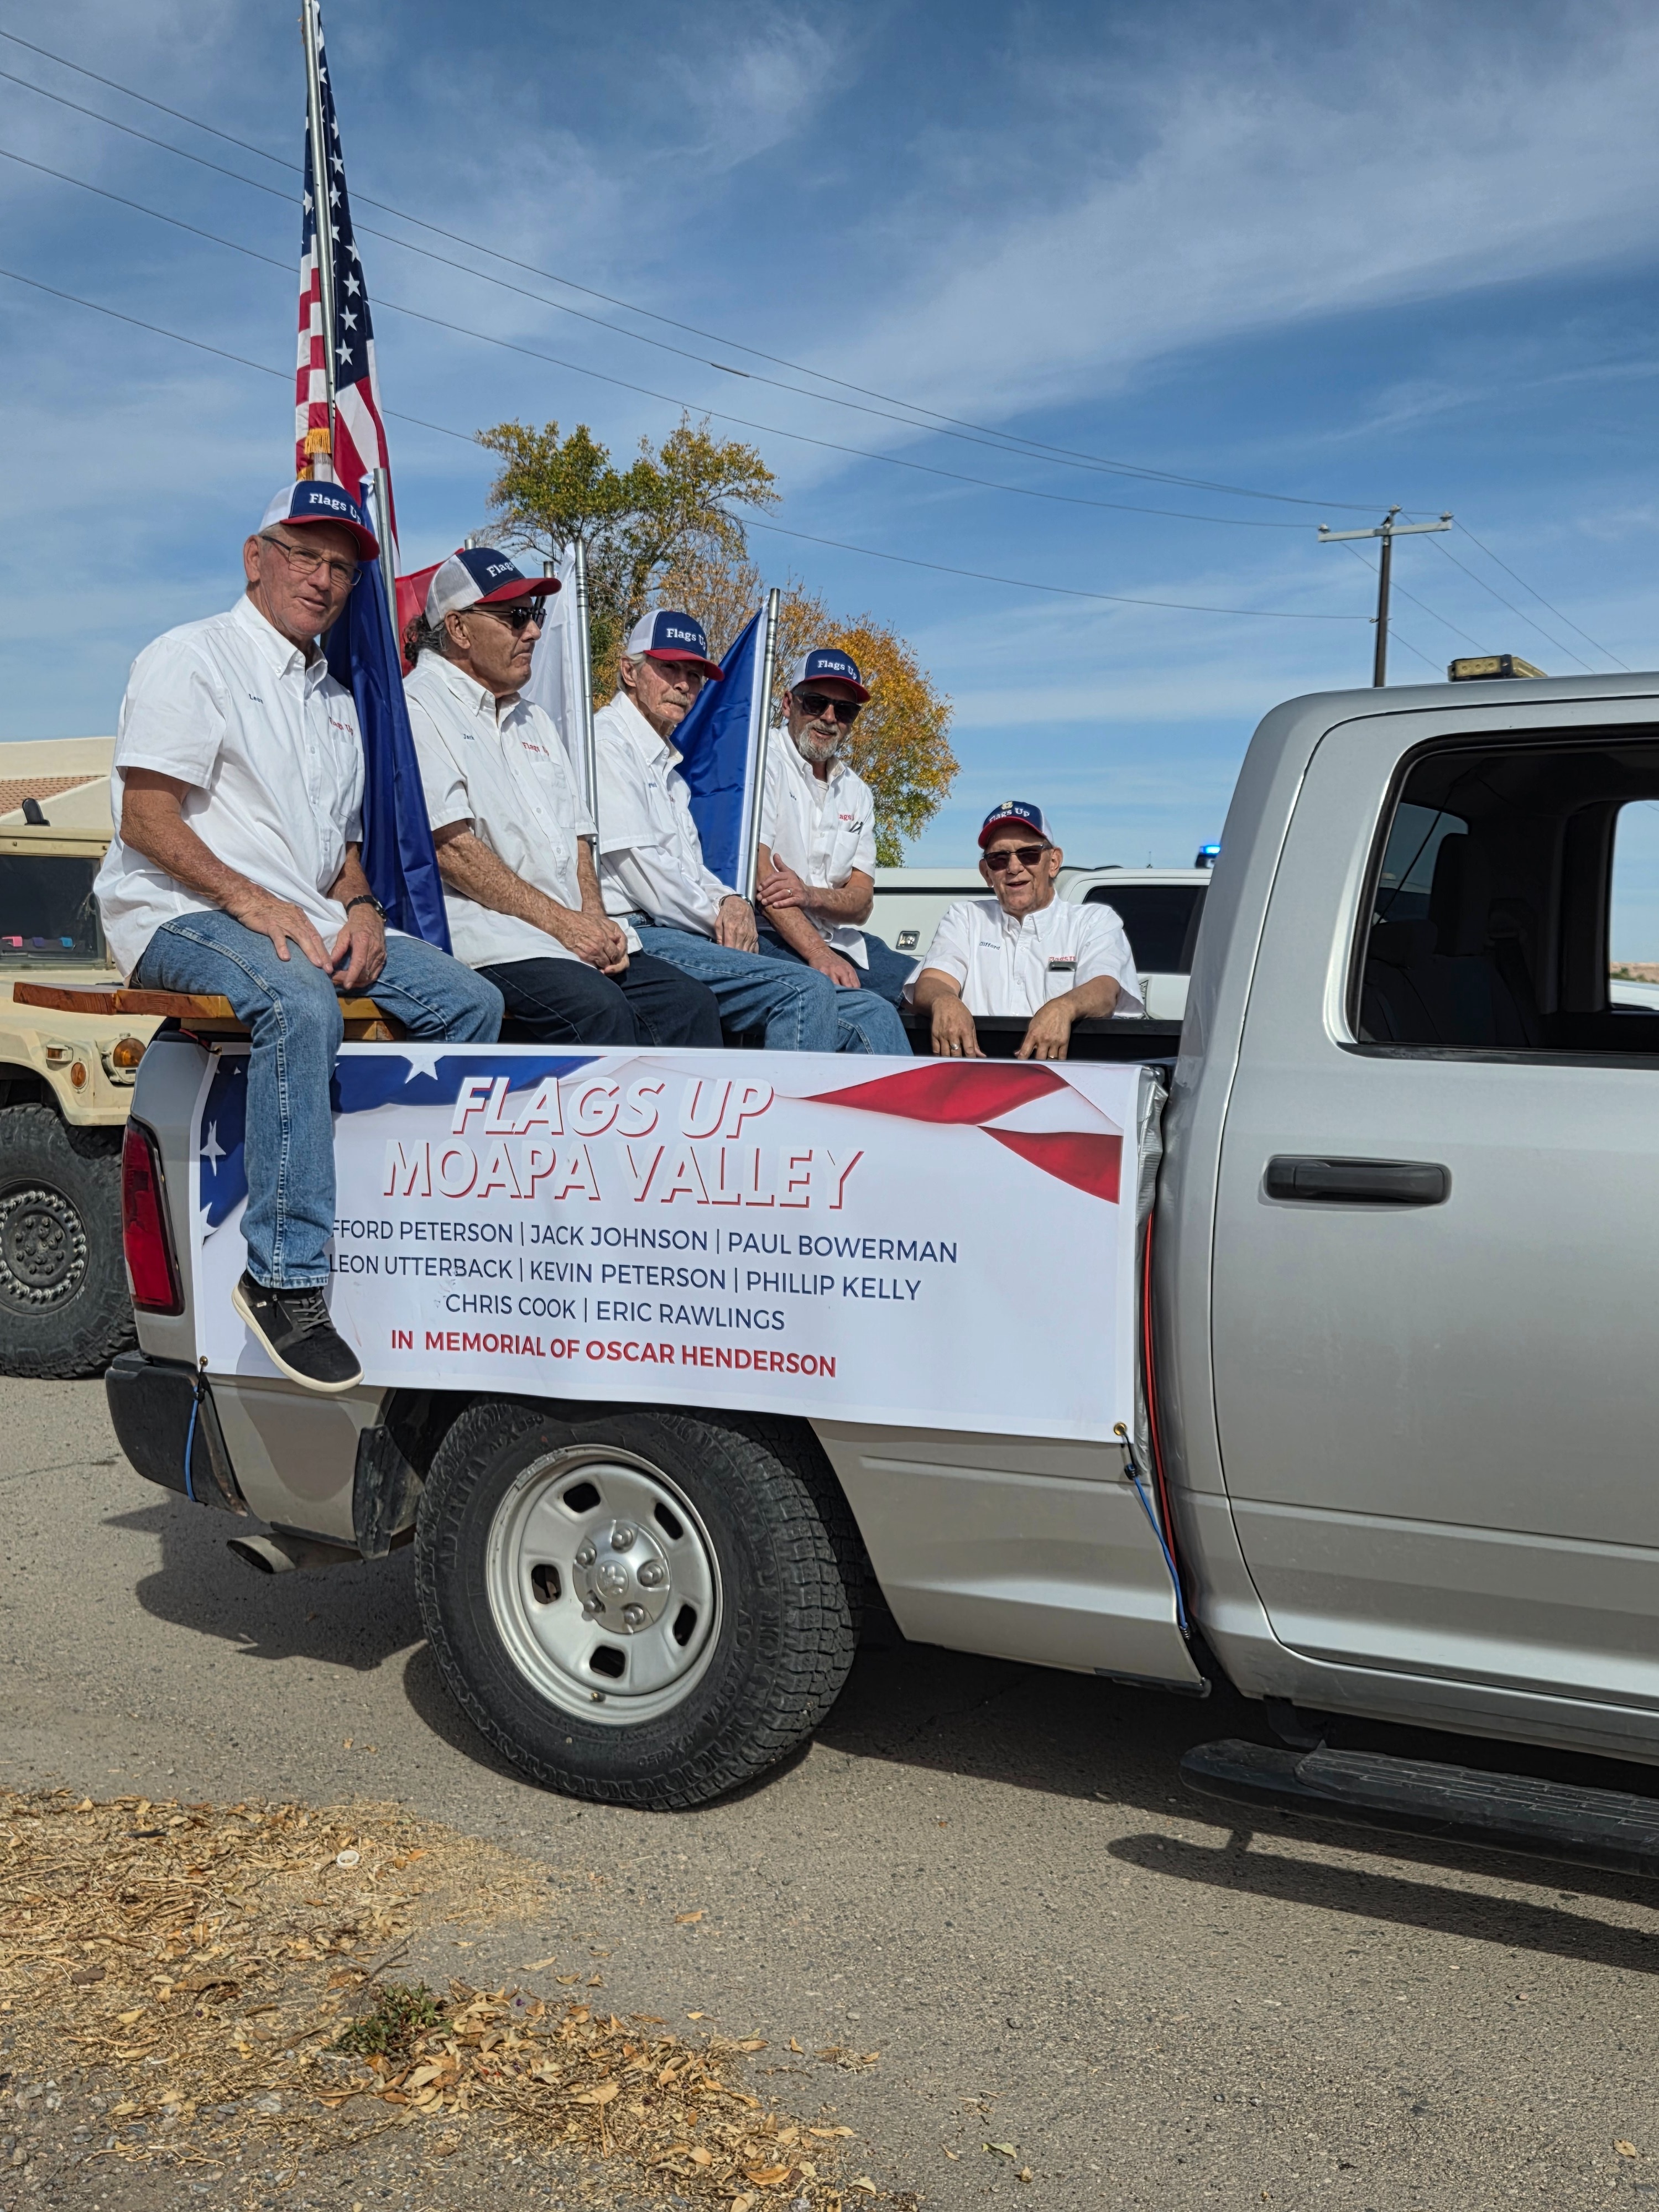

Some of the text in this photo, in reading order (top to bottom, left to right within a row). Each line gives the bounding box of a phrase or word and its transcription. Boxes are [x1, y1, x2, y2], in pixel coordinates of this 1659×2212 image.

[309, 493, 361, 525] Flags Up
[486, 561, 515, 577] Flags
[666, 628, 706, 651] Flags Up
[817, 660, 857, 681] Flags Up
[248, 693, 264, 705] Leon
[1014, 807, 1030, 817] Up
[979, 941, 1000, 950] Clifford
[451, 1076, 774, 1140] FLAGS UP
[383, 1138, 865, 1210] MOAPA VALLEY
[333, 1220, 394, 1239] FFORD
[400, 1221, 513, 1243] PETERSON
[530, 1224, 585, 1246] JACK
[591, 1227, 707, 1251] JOHNSON
[729, 1232, 792, 1255] PAUL
[799, 1235, 957, 1264] BOWERMAN
[330, 1254, 378, 1274] LEON
[385, 1256, 513, 1279] UTTERBACK
[530, 1260, 592, 1283] KEVIN
[602, 1264, 726, 1290] PETERSON
[747, 1271, 835, 1296] PHILLIP
[843, 1276, 921, 1301] KELLY
[446, 1293, 513, 1314] CHRIS
[518, 1297, 576, 1319] COOK
[597, 1301, 652, 1322] ERIC
[660, 1303, 785, 1331] RAWLINGS
[392, 1329, 837, 1378] IN MEMORIAL OF OSCAR HENDERSON
